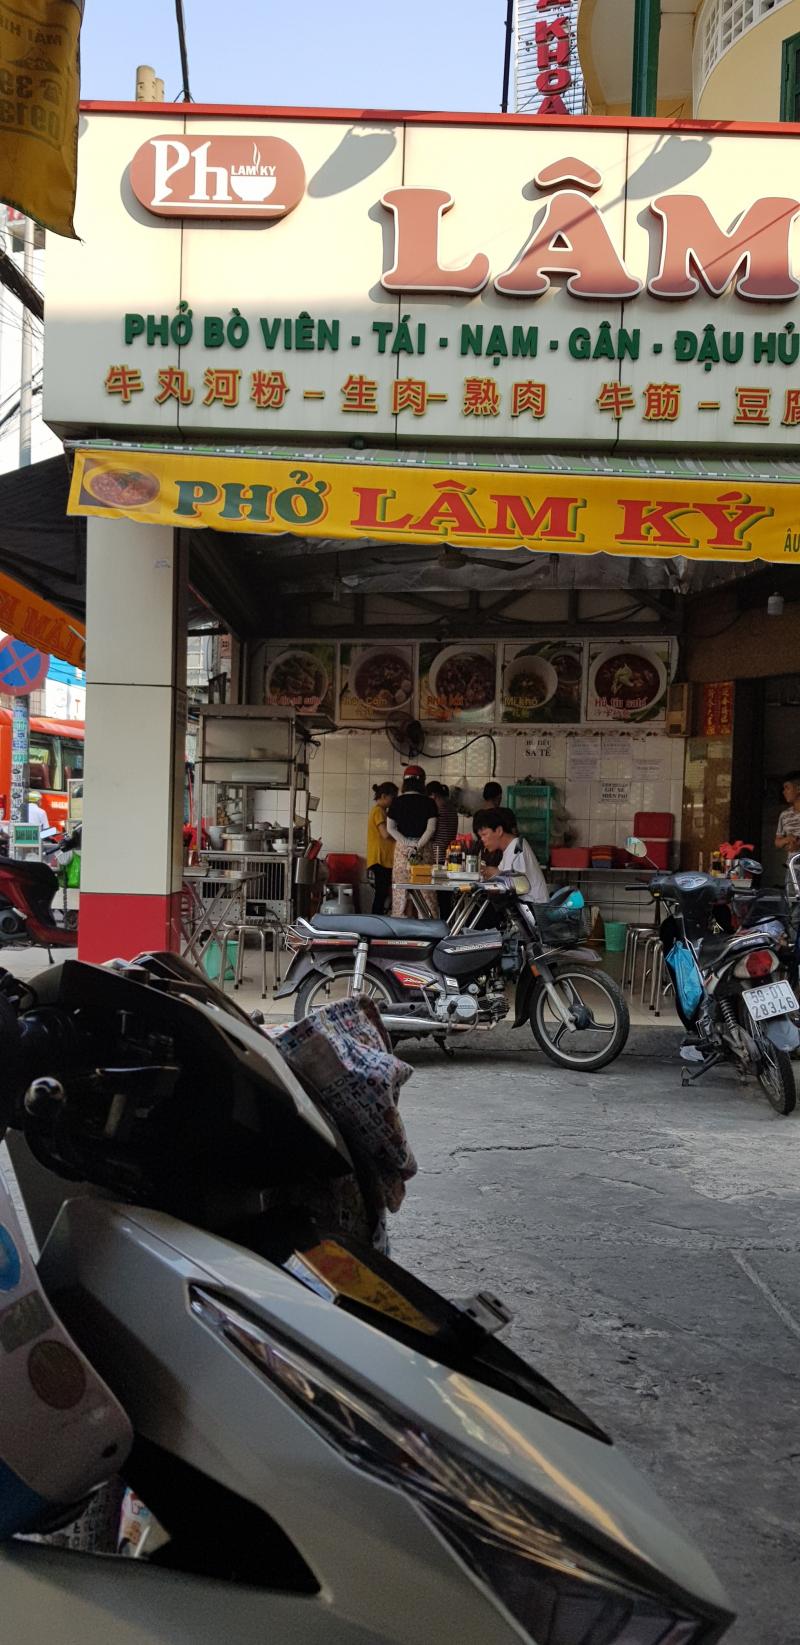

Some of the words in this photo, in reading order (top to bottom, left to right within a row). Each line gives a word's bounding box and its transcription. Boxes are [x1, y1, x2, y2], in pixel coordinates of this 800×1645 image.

[535, 16, 571, 115] KHOA
[231, 165, 256, 176] LAM
[260, 165, 276, 176] KY
[380, 156, 800, 300] LÂM
[124, 300, 193, 346] PHỞ
[204, 307, 249, 348] BÒ
[260, 311, 340, 350] VIÊN
[372, 314, 426, 354] TÁI
[460, 324, 539, 366] NẠM
[568, 320, 640, 360] GÂN
[674, 323, 744, 371] ĐẬU
[753, 321, 800, 365] HỦ
[104, 364, 290, 409] 牛丸河粉
[463, 376, 548, 419] 熟肉
[596, 381, 682, 422] 牛筋
[174, 470, 331, 526] PHỞ
[350, 479, 586, 543] LÂM
[614, 491, 773, 550] KÝ
[752, 997, 795, 1018] 283.46
